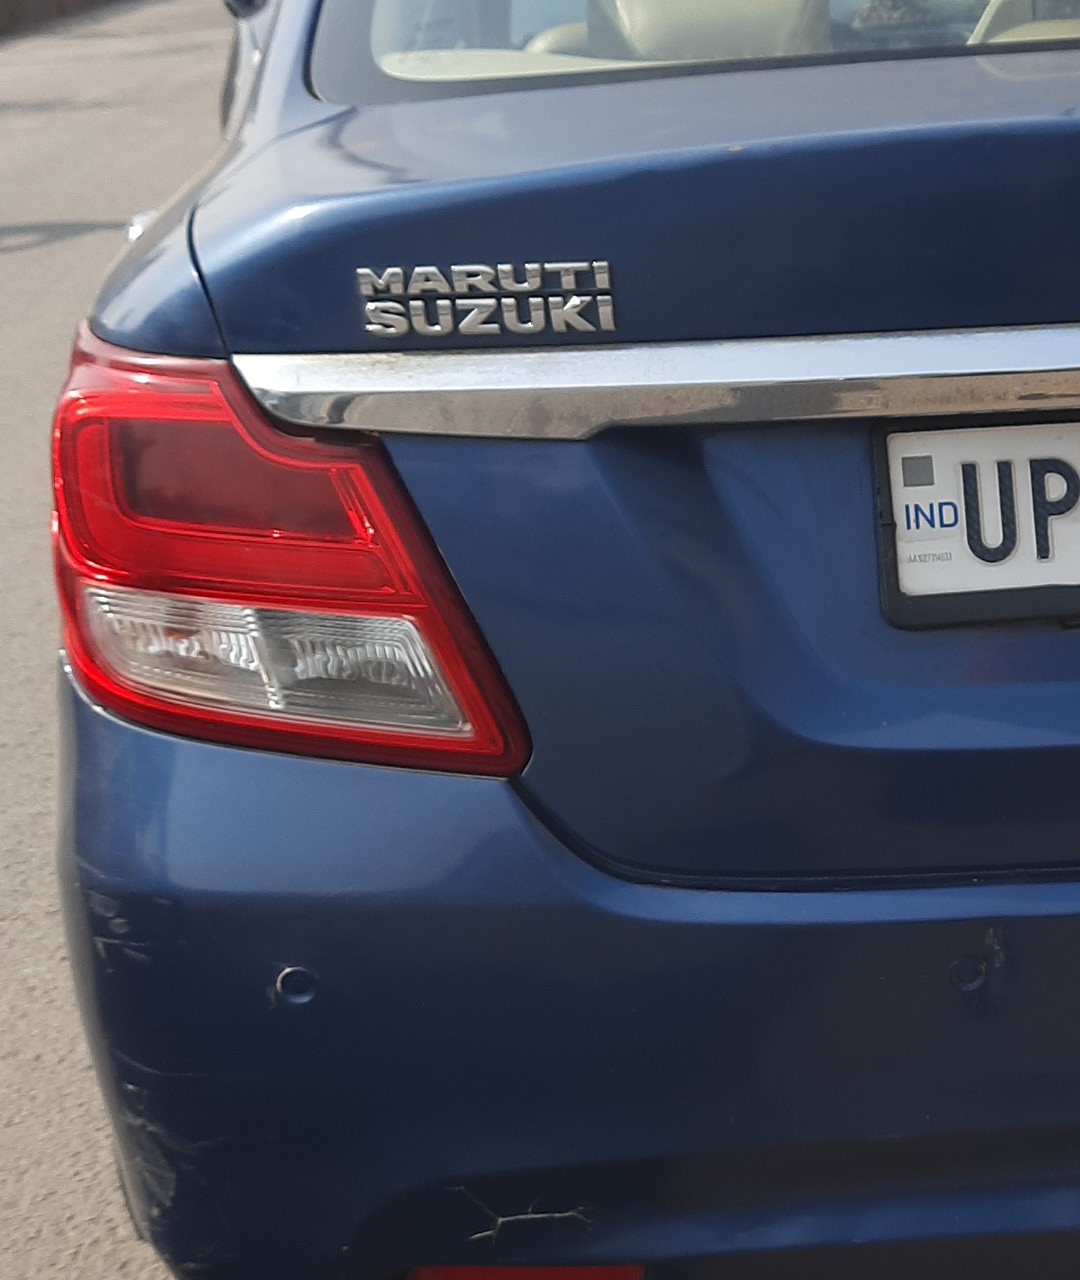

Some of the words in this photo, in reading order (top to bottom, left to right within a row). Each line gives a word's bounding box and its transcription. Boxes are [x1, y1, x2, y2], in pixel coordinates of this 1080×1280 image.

[356, 261, 611, 296] MARUTI
[365, 295, 616, 337] SUZUKI
[904, 501, 959, 530] IND
